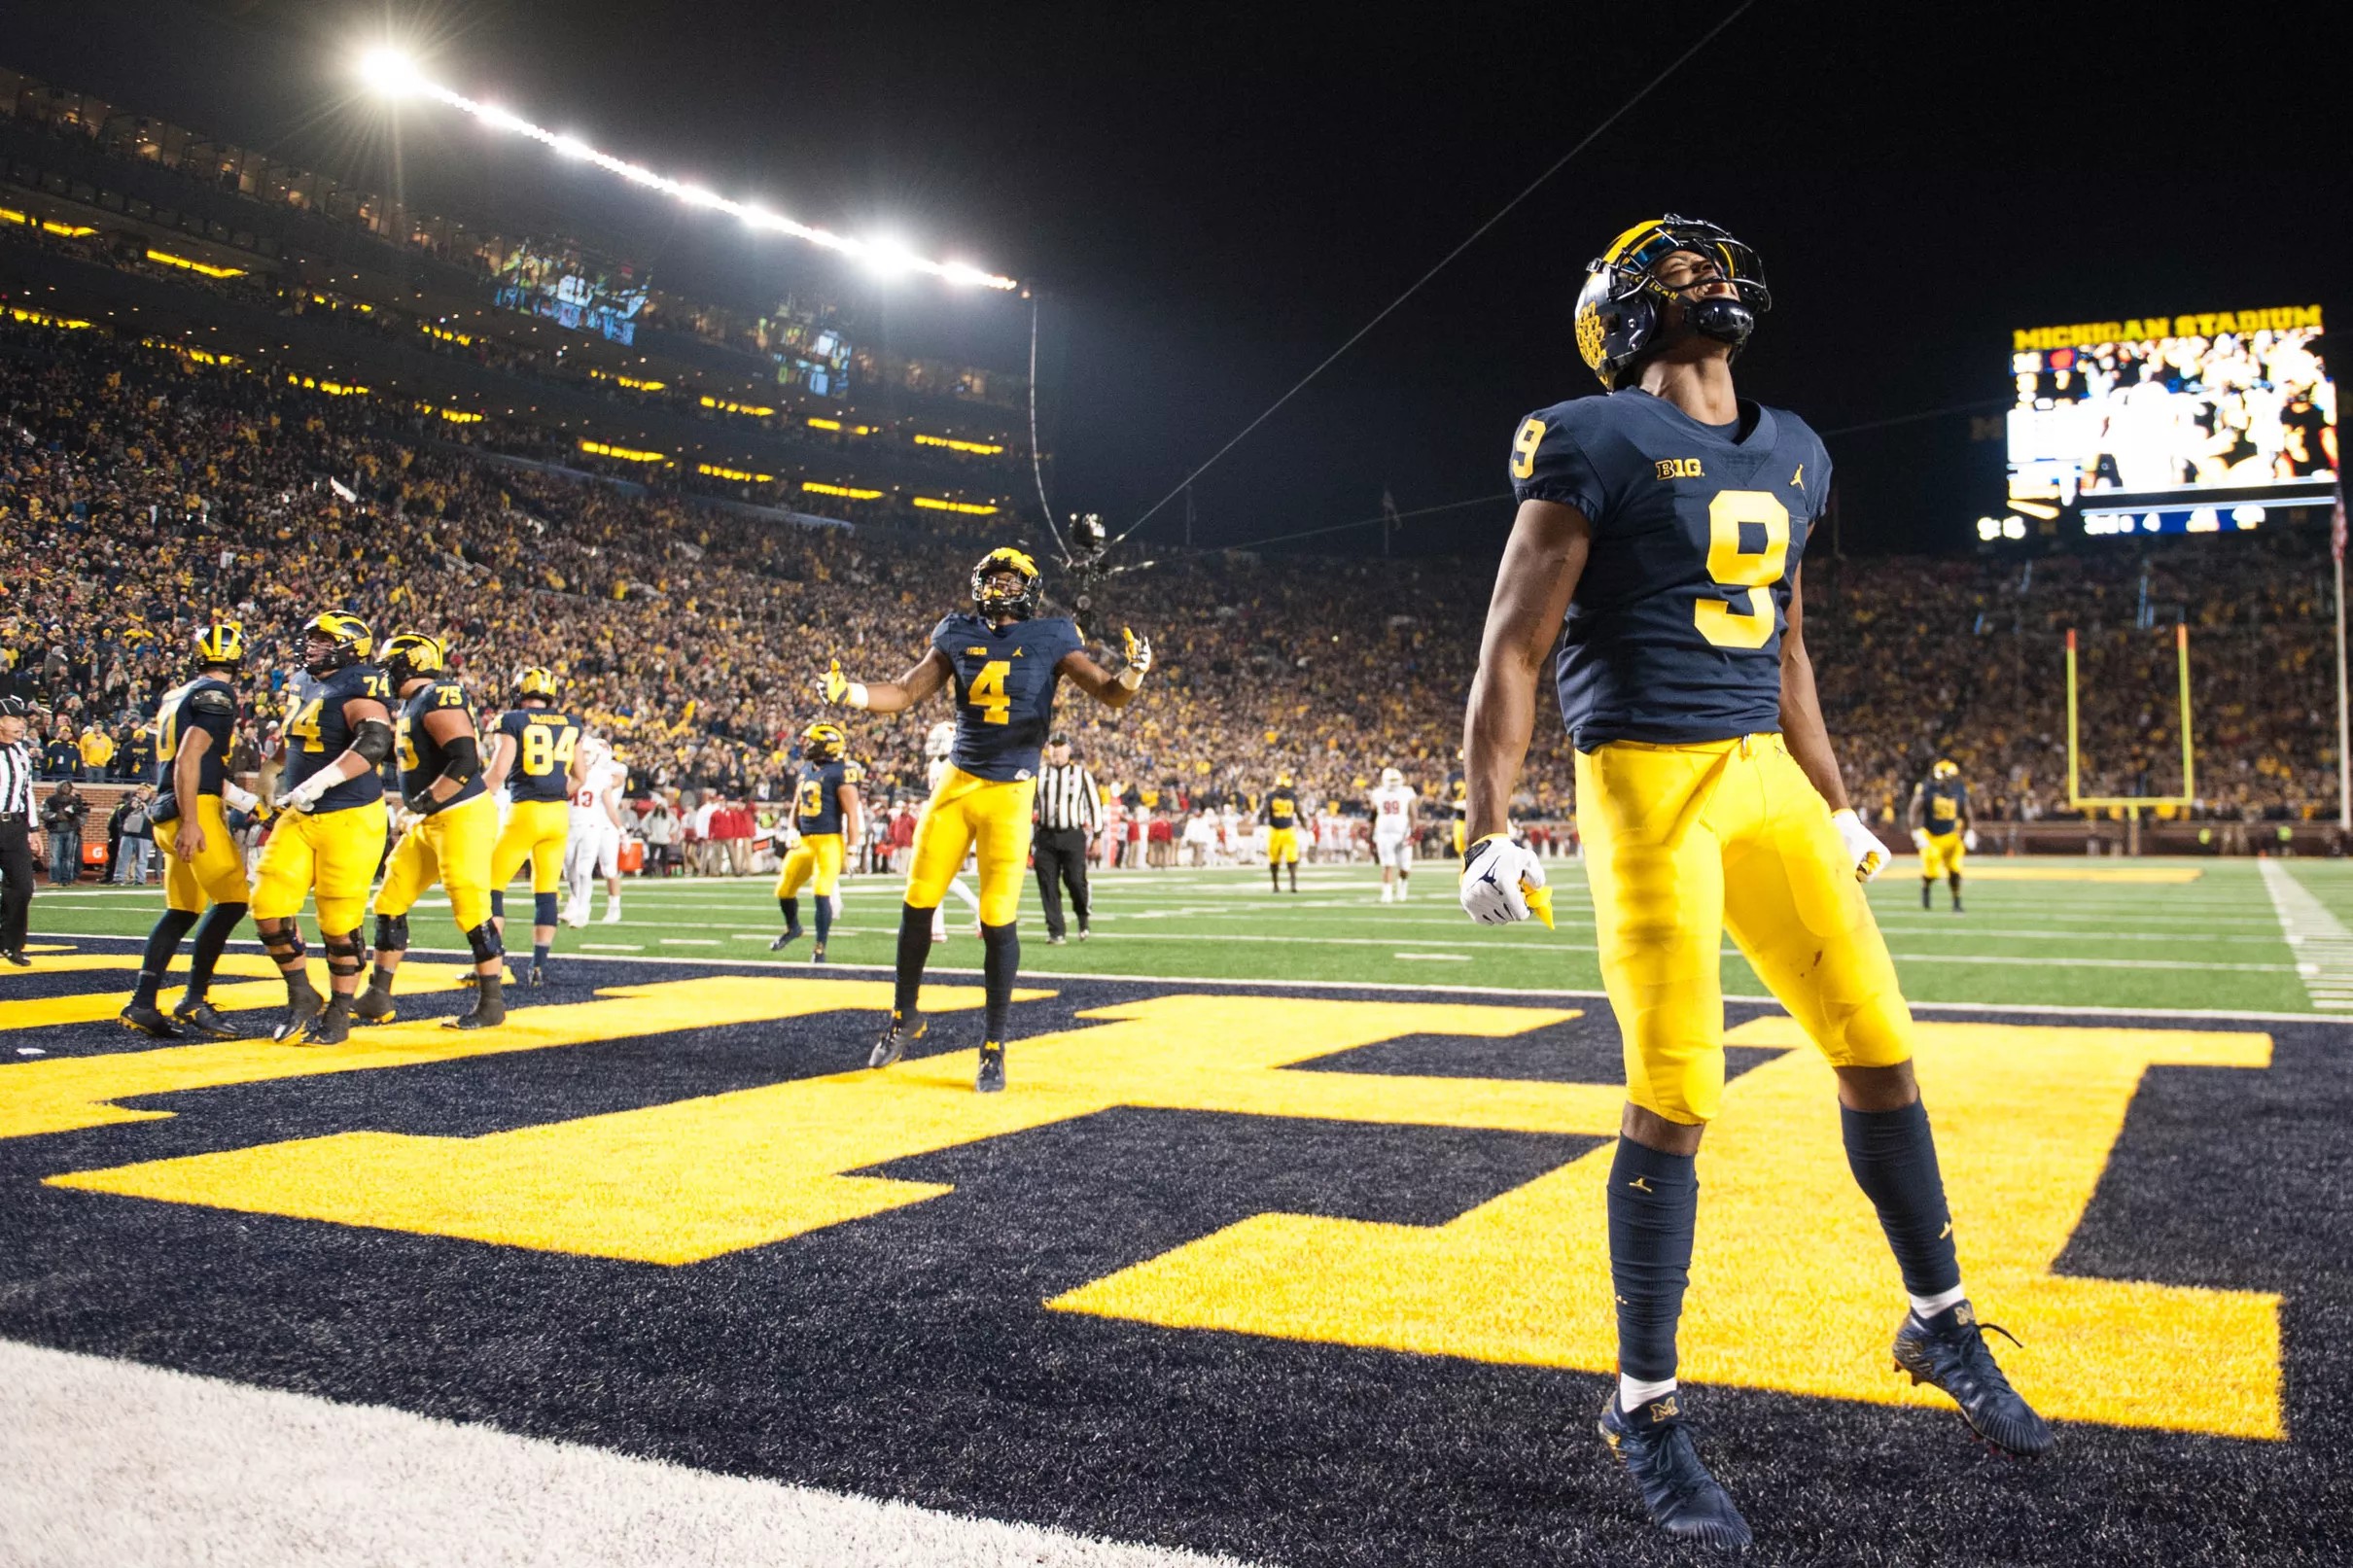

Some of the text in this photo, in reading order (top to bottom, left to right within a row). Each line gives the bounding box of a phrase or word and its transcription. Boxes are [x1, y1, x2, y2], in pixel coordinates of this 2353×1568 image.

[2013, 303, 2323, 350] MICHIGAN STADIUM
[1511, 418, 1546, 479] 9
[1694, 489, 1790, 649] 9
[363, 676, 391, 697] 74
[436, 685, 463, 707] 75
[968, 660, 1010, 725] 4
[523, 724, 579, 776] 84
[92, 847, 103, 858] G
[1649, 1396, 1680, 1422] M
